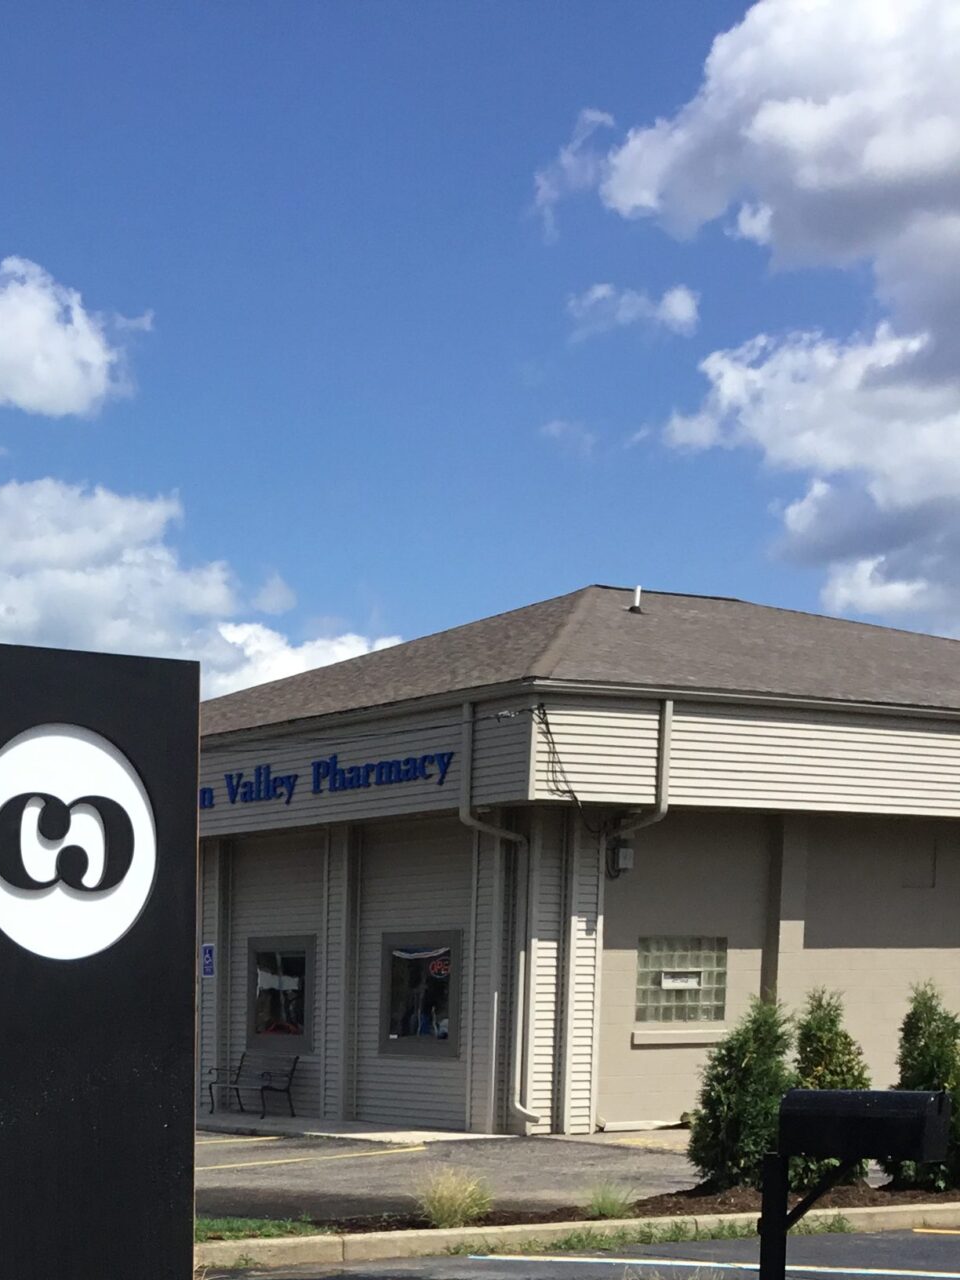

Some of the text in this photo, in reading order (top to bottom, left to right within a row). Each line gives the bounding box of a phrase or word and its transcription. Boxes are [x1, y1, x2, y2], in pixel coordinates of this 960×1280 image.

[224, 764, 298, 805] Valley
[311, 752, 454, 795] Pharmacy
[430, 959, 450, 976] OPE
